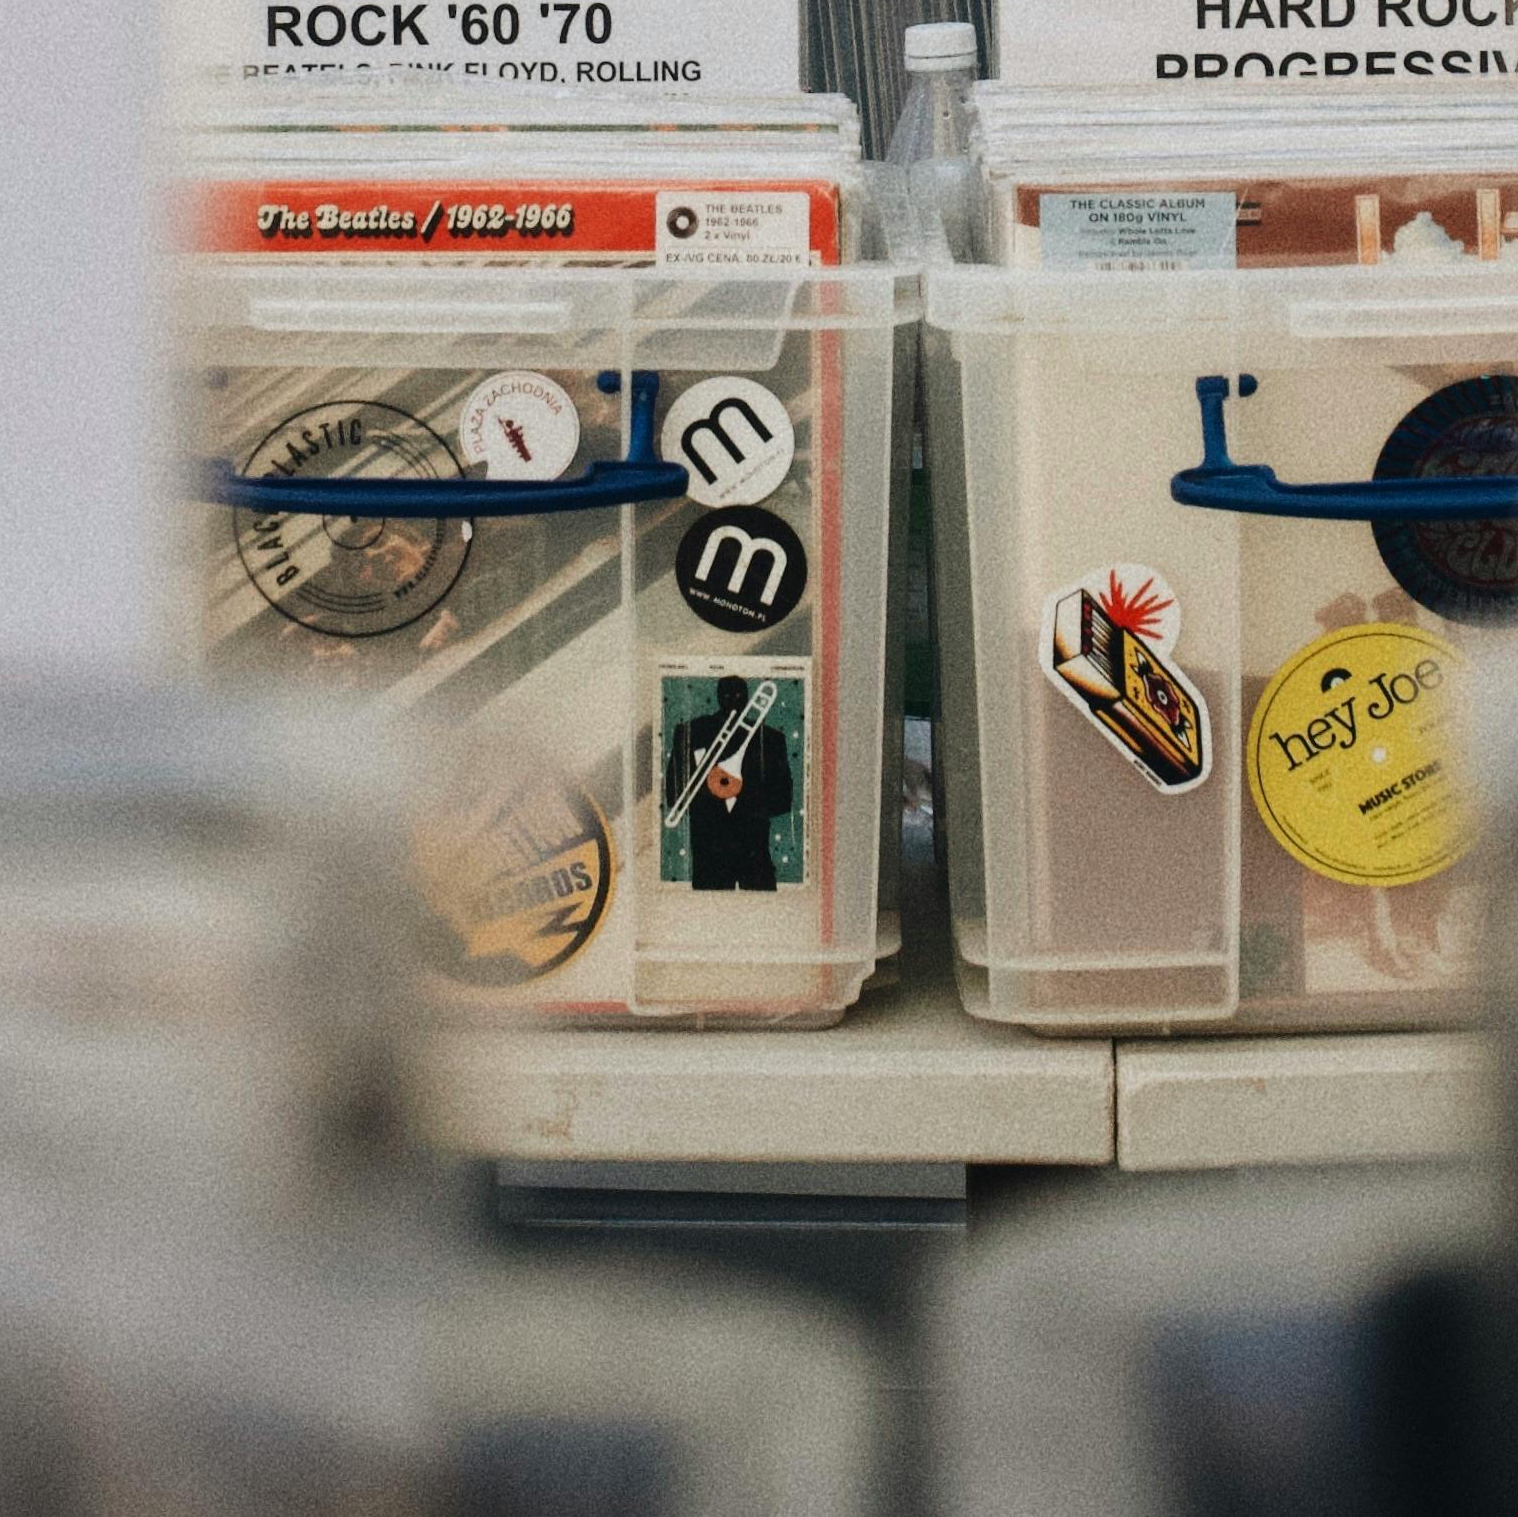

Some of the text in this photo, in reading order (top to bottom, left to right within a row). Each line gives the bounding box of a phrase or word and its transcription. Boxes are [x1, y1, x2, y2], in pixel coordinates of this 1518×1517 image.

[267, 2, 613, 48] ROCK '60 '70
[577, 60, 702, 83] ROLLING
[705, 204, 783, 214] THE BEATLES
[1071, 198, 1206, 209] THE CLASSIC ALBUM
[257, 203, 311, 233] The
[316, 203, 415, 234] Beatles
[446, 203, 575, 234] 1962-1966
[1088, 212, 1187, 224] ON 180g VINYL
[724, 230, 751, 241] Vinyl
[263, 417, 363, 479] LASTIC
[1268, 658, 1444, 772] hey Joe
[1358, 782, 1403, 816] MUSIC
